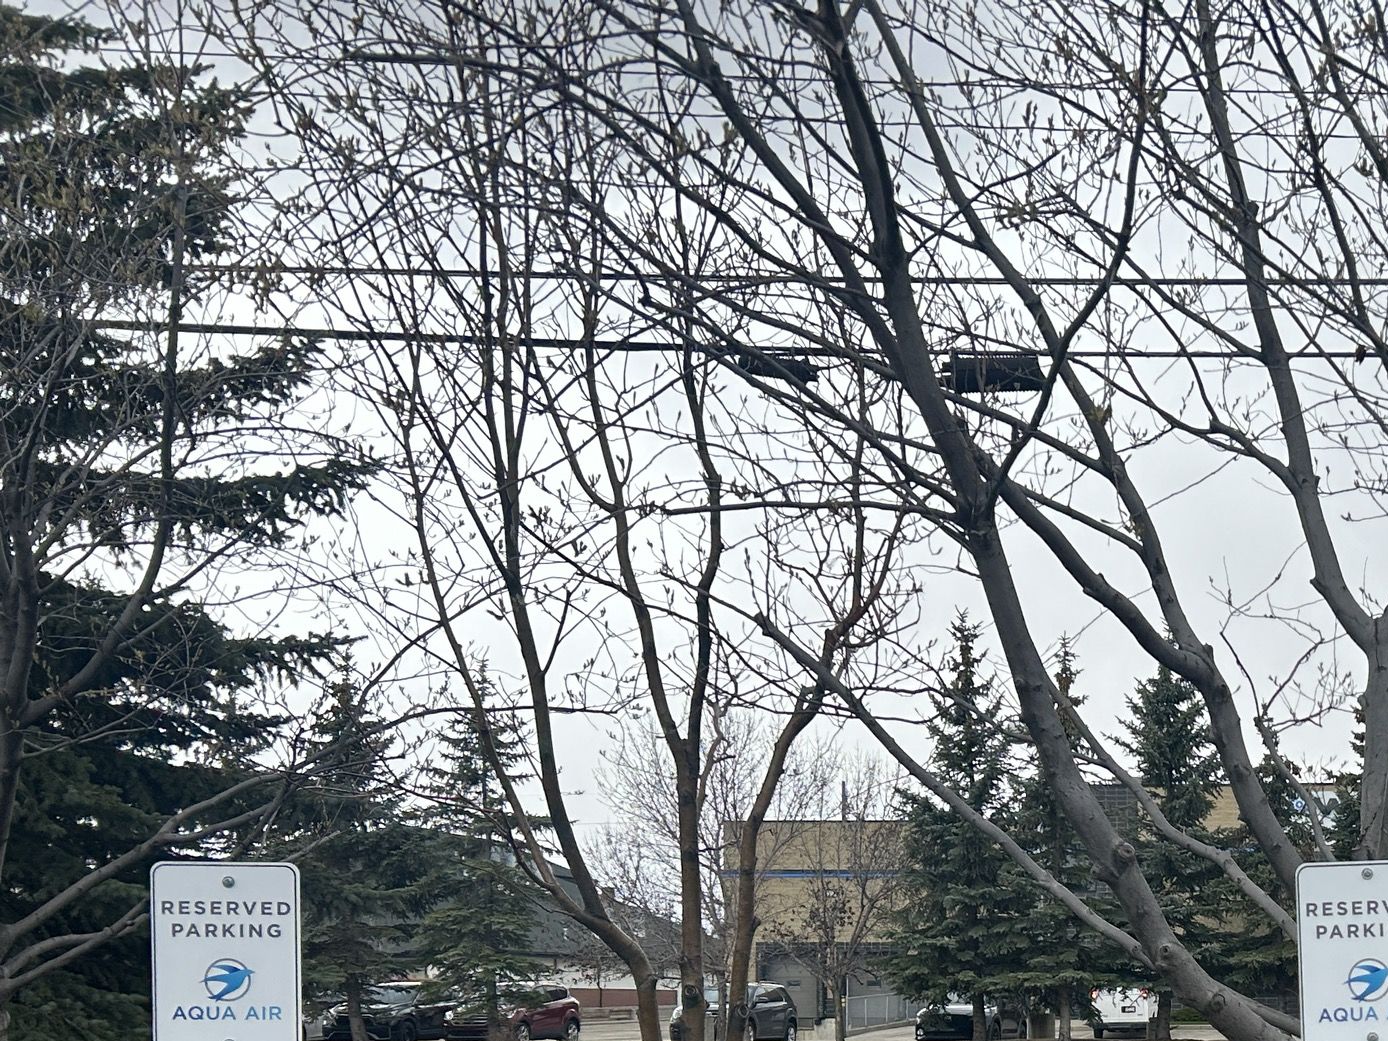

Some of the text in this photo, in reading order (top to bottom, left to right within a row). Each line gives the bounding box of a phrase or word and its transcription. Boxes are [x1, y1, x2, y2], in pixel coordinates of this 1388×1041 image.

[161, 900, 291, 916] RESERVED
[171, 923, 282, 938] PARKING
[172, 1006, 282, 1020] AQUA AIR
[1318, 1006, 1379, 1023] AQUA
